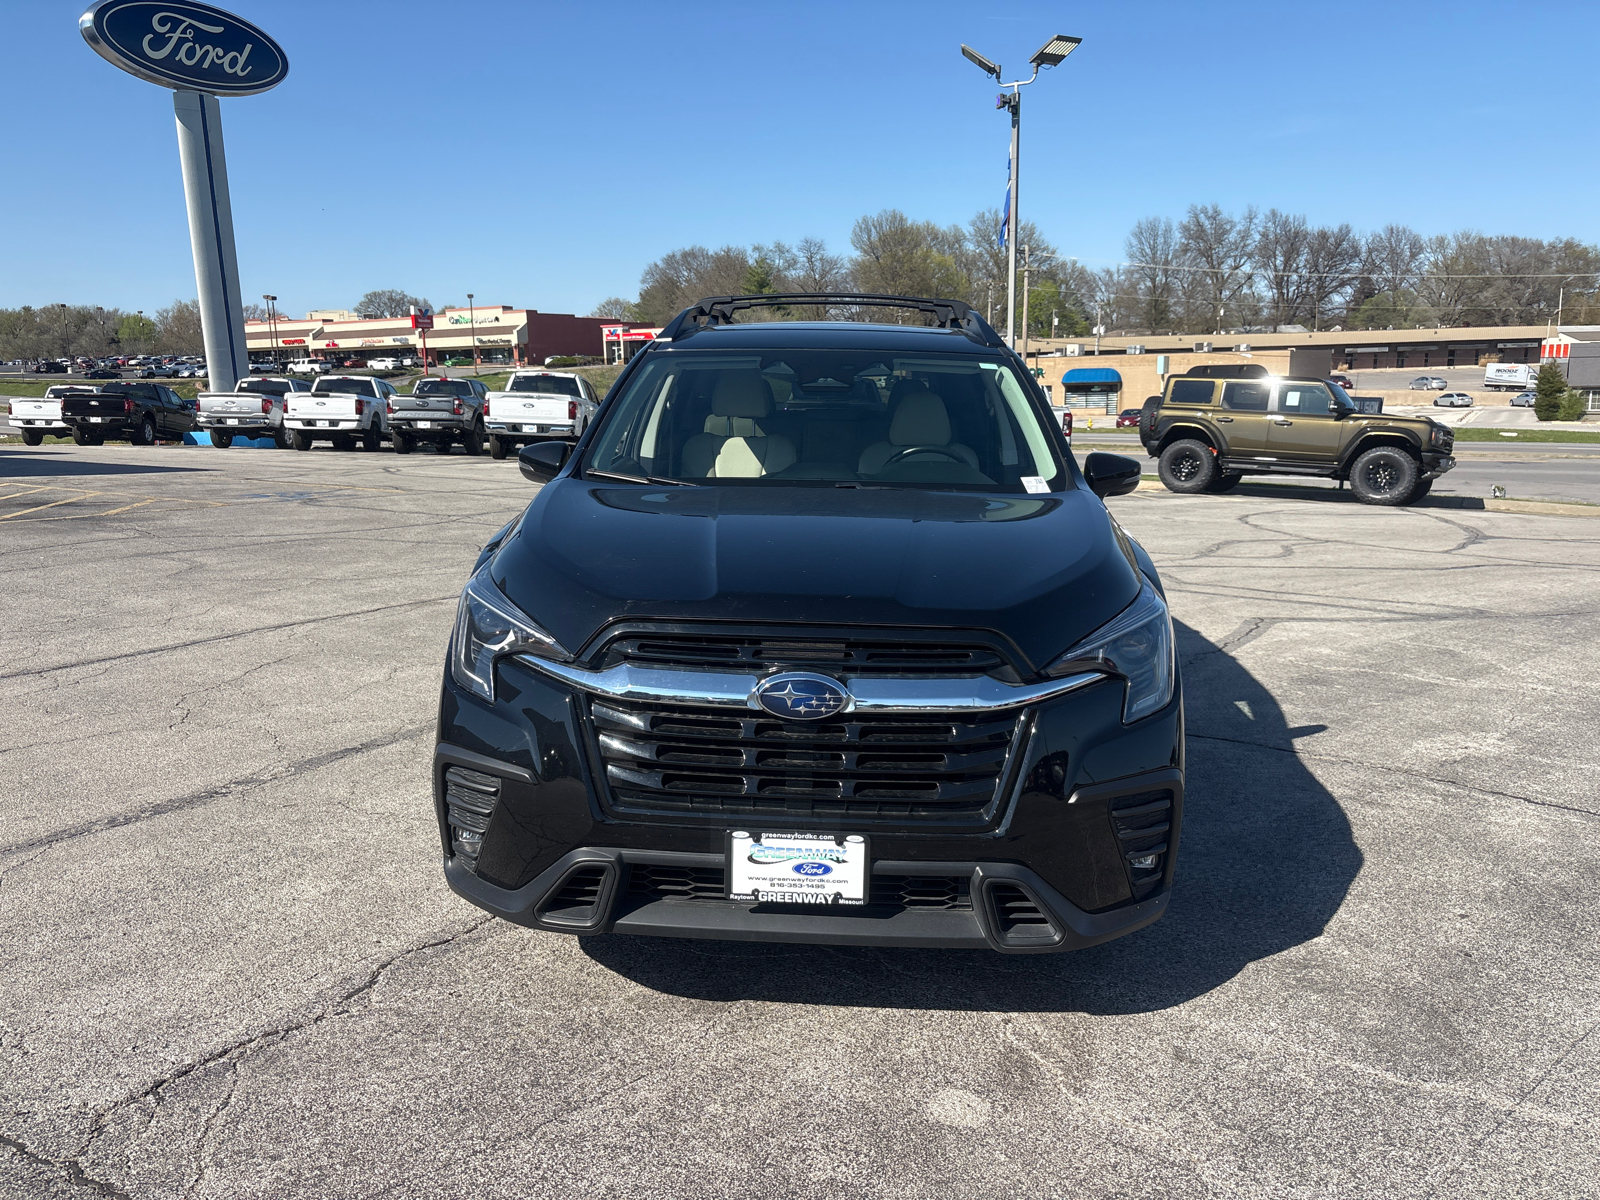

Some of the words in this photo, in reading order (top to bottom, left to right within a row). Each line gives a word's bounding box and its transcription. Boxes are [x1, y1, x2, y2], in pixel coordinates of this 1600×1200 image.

[142, 12, 253, 77] Ford
[761, 832, 835, 841] greenwayfordkc.com
[750, 843, 848, 861] GREENWAY
[800, 863, 825, 874] Ford
[747, 876, 849, 885] www.greenwayfordkc.com
[729, 893, 755, 901] Raytown
[758, 891, 835, 904] GREENWAY
